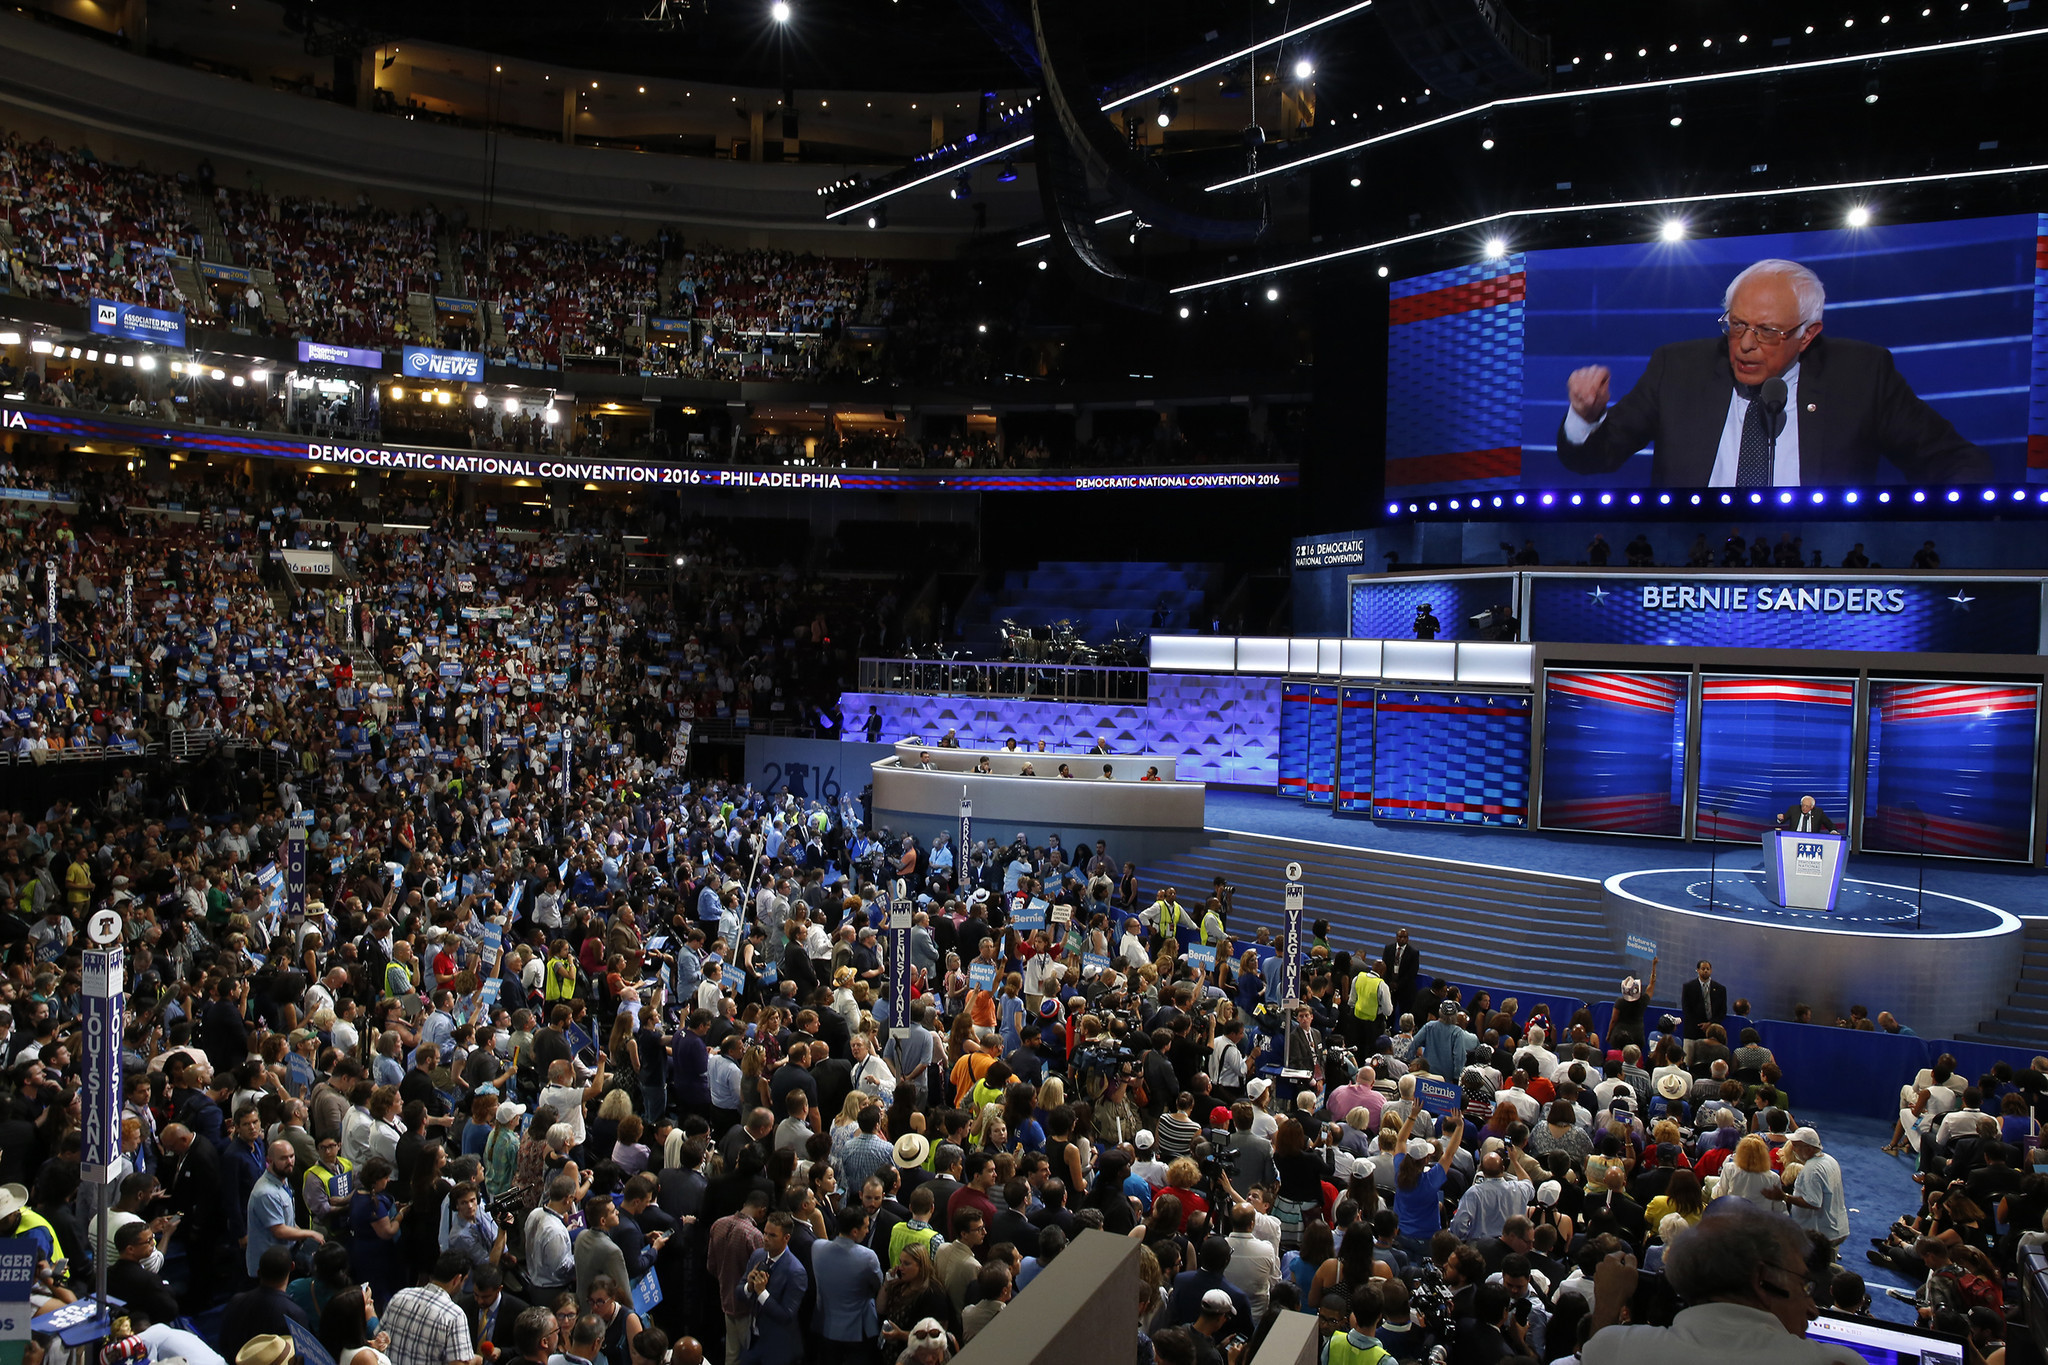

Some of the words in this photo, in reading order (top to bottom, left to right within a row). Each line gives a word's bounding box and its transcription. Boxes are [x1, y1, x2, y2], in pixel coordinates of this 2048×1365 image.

[100, 310, 115, 319] AP
[124, 313, 160, 328] ASSOCIATED
[160, 320, 179, 330] PRESS
[308, 344, 349, 358] Bloomberg
[308, 351, 336, 362] Politics
[444, 355, 464, 363] WARNER
[429, 359, 478, 376] NEWS
[308, 443, 436, 469] DEMOCRATIC
[441, 455, 535, 476] NATIONAL
[538, 462, 659, 482] CONVENTION
[663, 468, 701, 484] 2016
[720, 471, 841, 488] PHILADELPHIA
[1075, 477, 1137, 488] DEMOCRATIC
[1139, 476, 1187, 487] NATIONAL
[1189, 475, 1256, 486] CONVENTION
[1257, 474, 1280, 485] 2016
[1317, 540, 1364, 554] DEMOCRATIC
[1295, 556, 1322, 566] NATIONAL
[1324, 553, 1363, 564] CONVENTION
[313, 564, 331, 574] 105
[48, 580, 56, 620] KANSAS
[1642, 586, 1748, 609] BERNIE
[1756, 588, 1905, 612] SANDERS
[289, 842, 303, 912] IOWA
[1014, 913, 1044, 922] Bernie
[1627, 940, 1648, 951] believe
[1632, 936, 1650, 946] future
[85, 954, 105, 964] 2016
[1188, 949, 1215, 963] Bernie
[1286, 910, 1299, 998] VIRGINIA
[762, 967, 777, 977] rnie
[970, 972, 985, 980] believe
[974, 965, 988, 973] future
[896, 929, 905, 1027] PENNSYLVANIA
[87, 998, 102, 1164] LOUISIANA
[110, 996, 120, 1162] LOUISIANA
[1421, 1082, 1456, 1099] Bernie
[0, 1254, 33, 1267] GER
[653, 1289, 659, 1303] to
